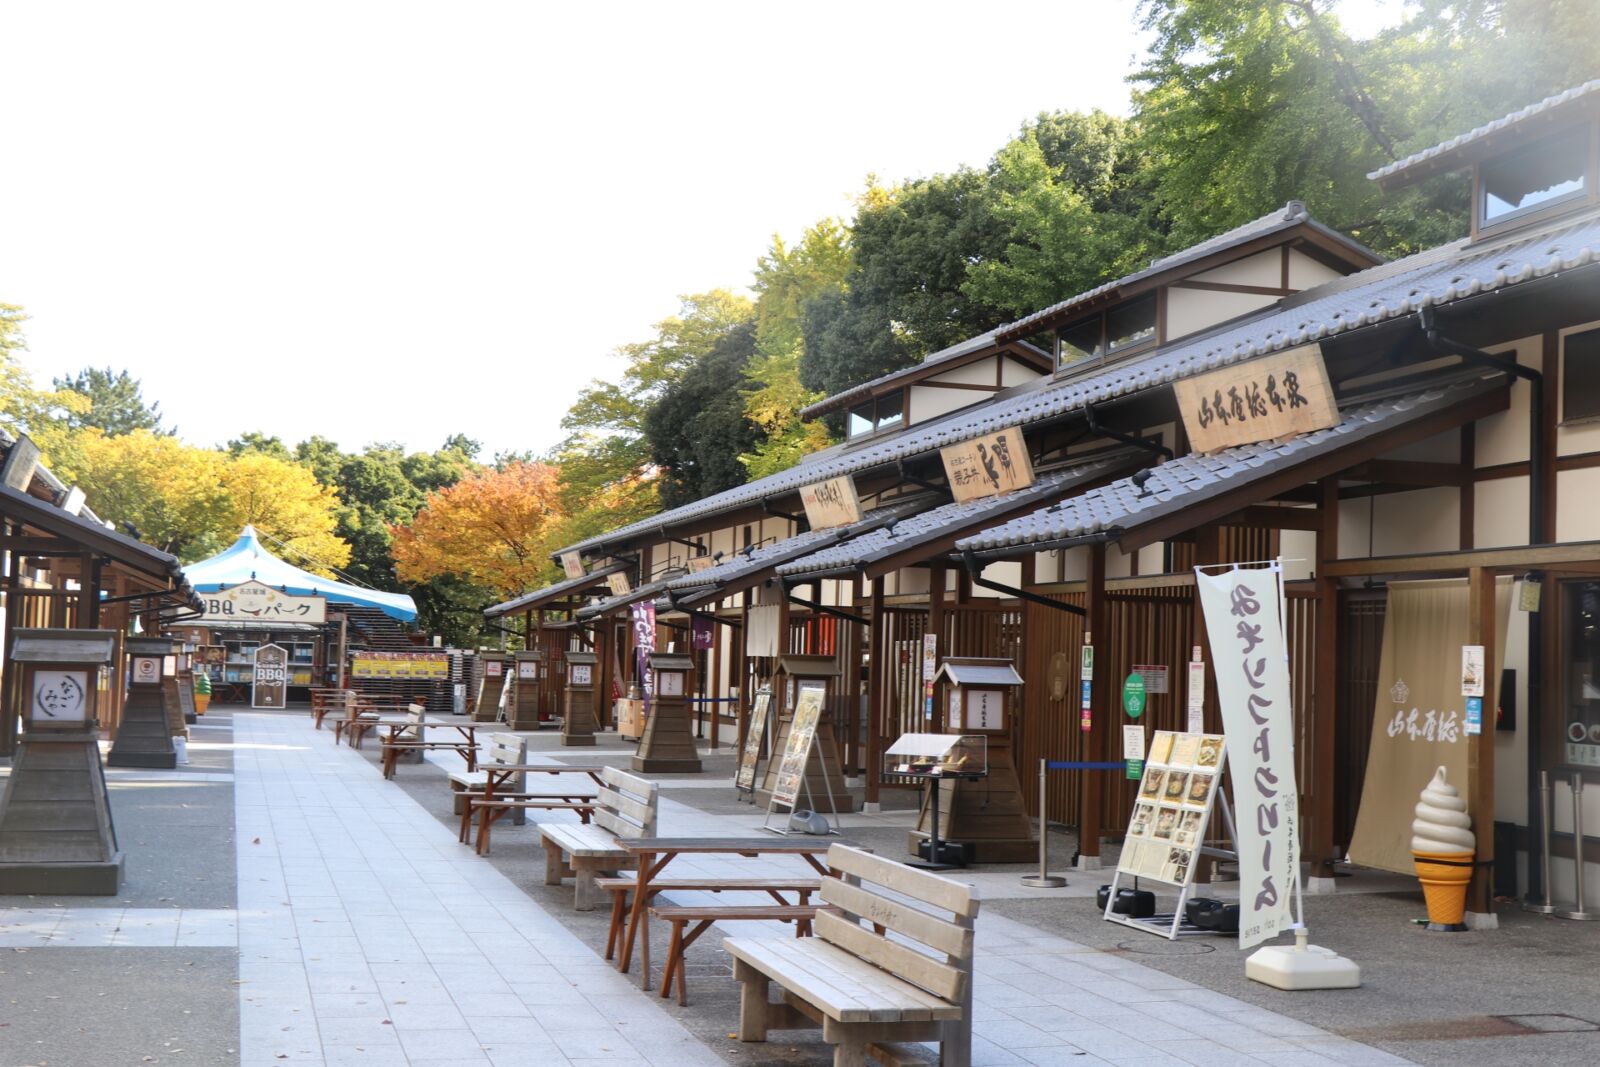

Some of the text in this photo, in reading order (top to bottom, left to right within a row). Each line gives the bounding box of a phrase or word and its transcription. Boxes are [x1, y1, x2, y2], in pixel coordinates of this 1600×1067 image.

[1198, 370, 1309, 429] 山本屋総本家
[204, 600, 311, 615] BQ パーク
[256, 668, 285, 681] BBQ
